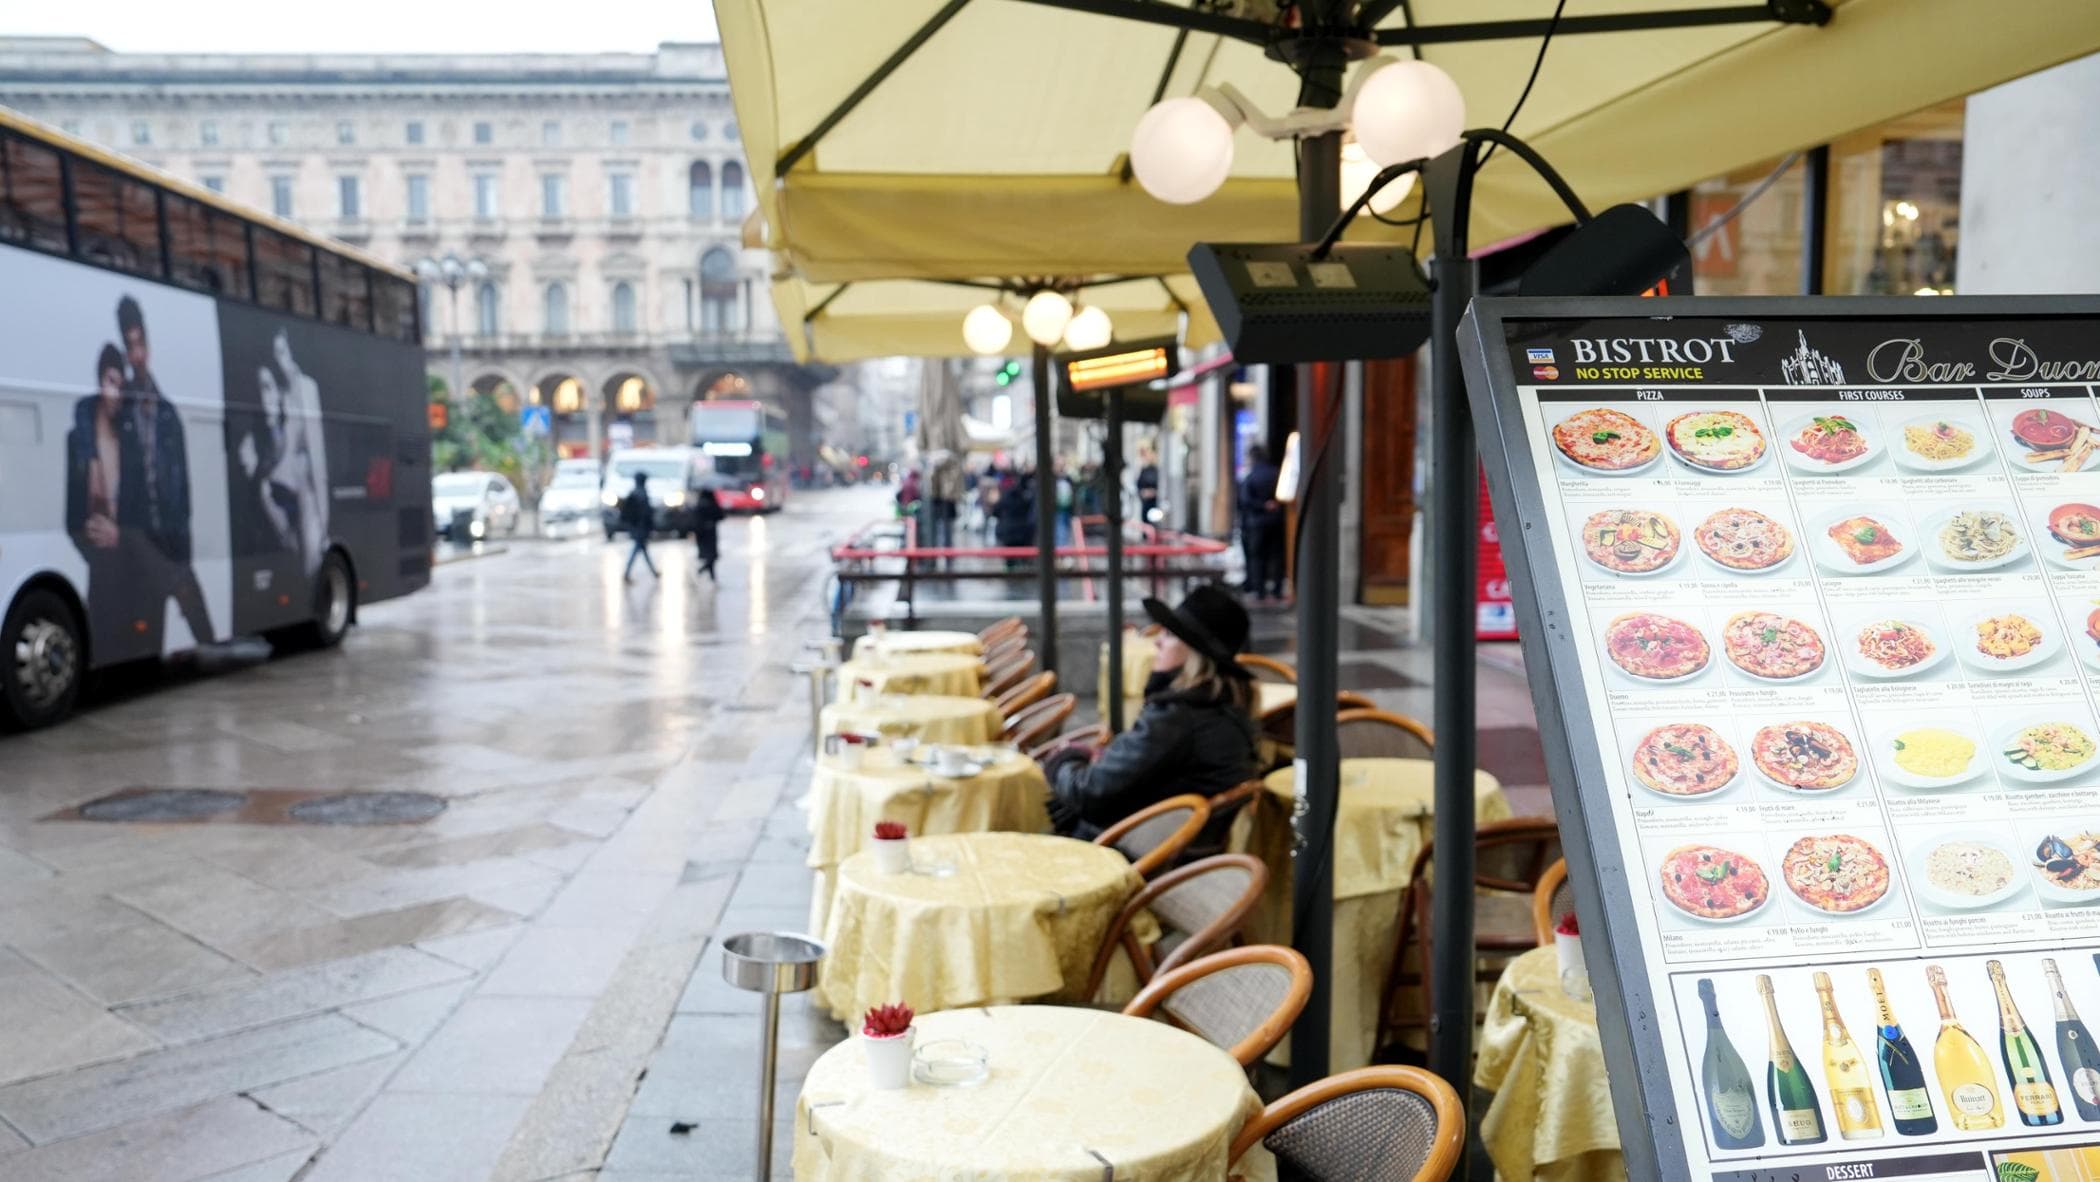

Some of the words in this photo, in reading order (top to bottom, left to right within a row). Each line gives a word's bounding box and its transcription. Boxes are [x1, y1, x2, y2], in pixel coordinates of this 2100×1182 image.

[1570, 338, 1736, 364] BISTROT
[1866, 338, 1976, 382] Bar
[1576, 367, 1600, 380] NO
[1601, 367, 1640, 380] STOP
[1644, 367, 1704, 380] SERVICE
[1636, 390, 1664, 400] PIZZA
[1838, 390, 1864, 400] FIRST
[1865, 390, 1904, 400] COURSES
[2020, 388, 2050, 399] SOUPS
[1826, 1162, 1874, 1180] DESSERT
